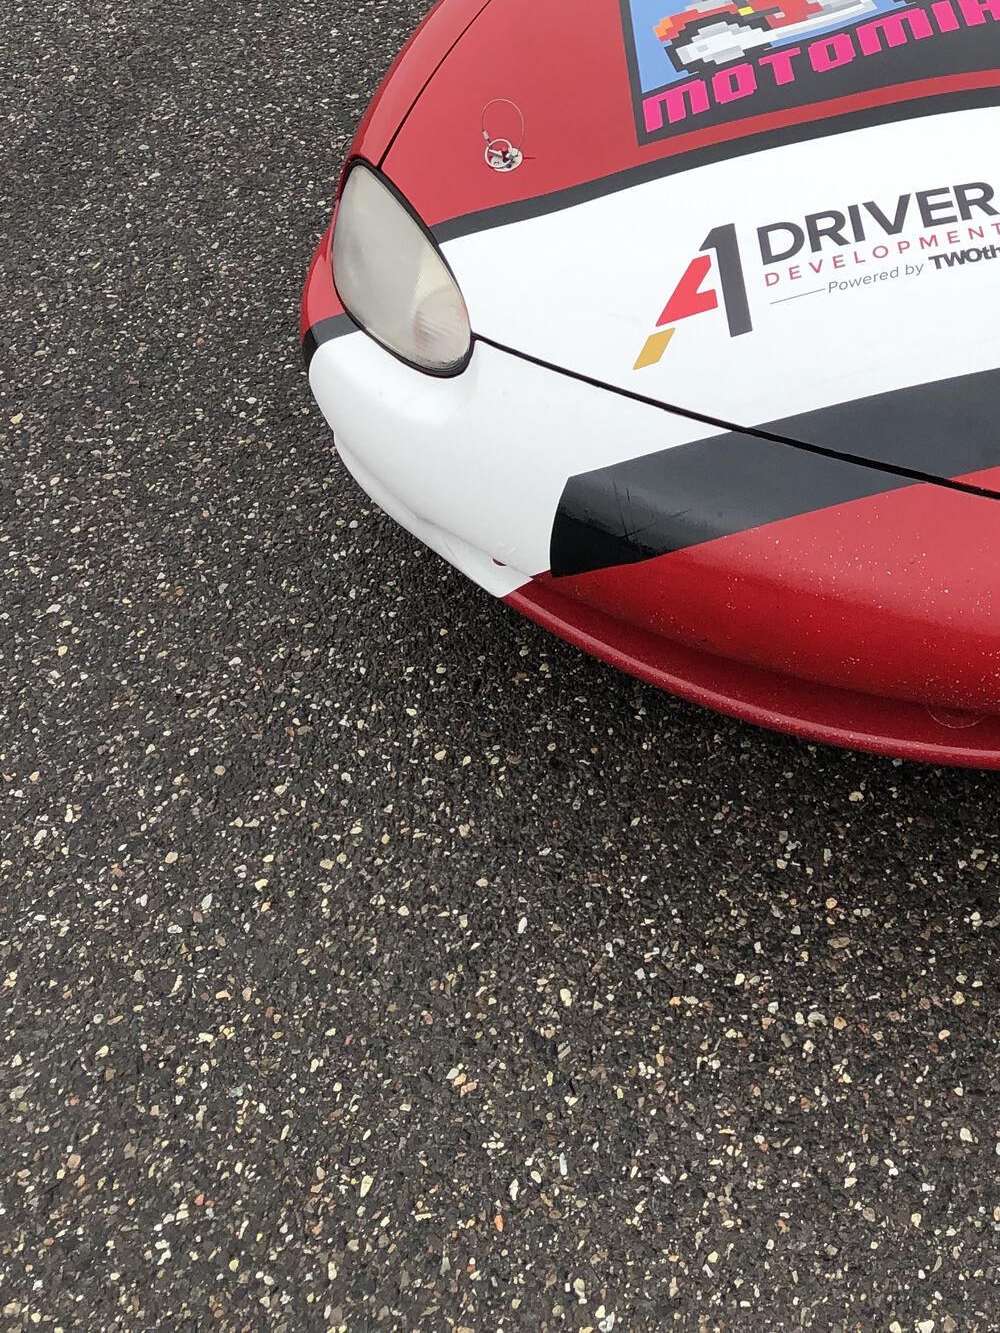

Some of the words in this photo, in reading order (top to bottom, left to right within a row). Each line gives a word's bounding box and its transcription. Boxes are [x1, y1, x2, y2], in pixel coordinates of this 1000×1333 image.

[756, 181, 1000, 266] DRIVER
[828, 265, 900, 294] Powered
[905, 261, 924, 278] by
